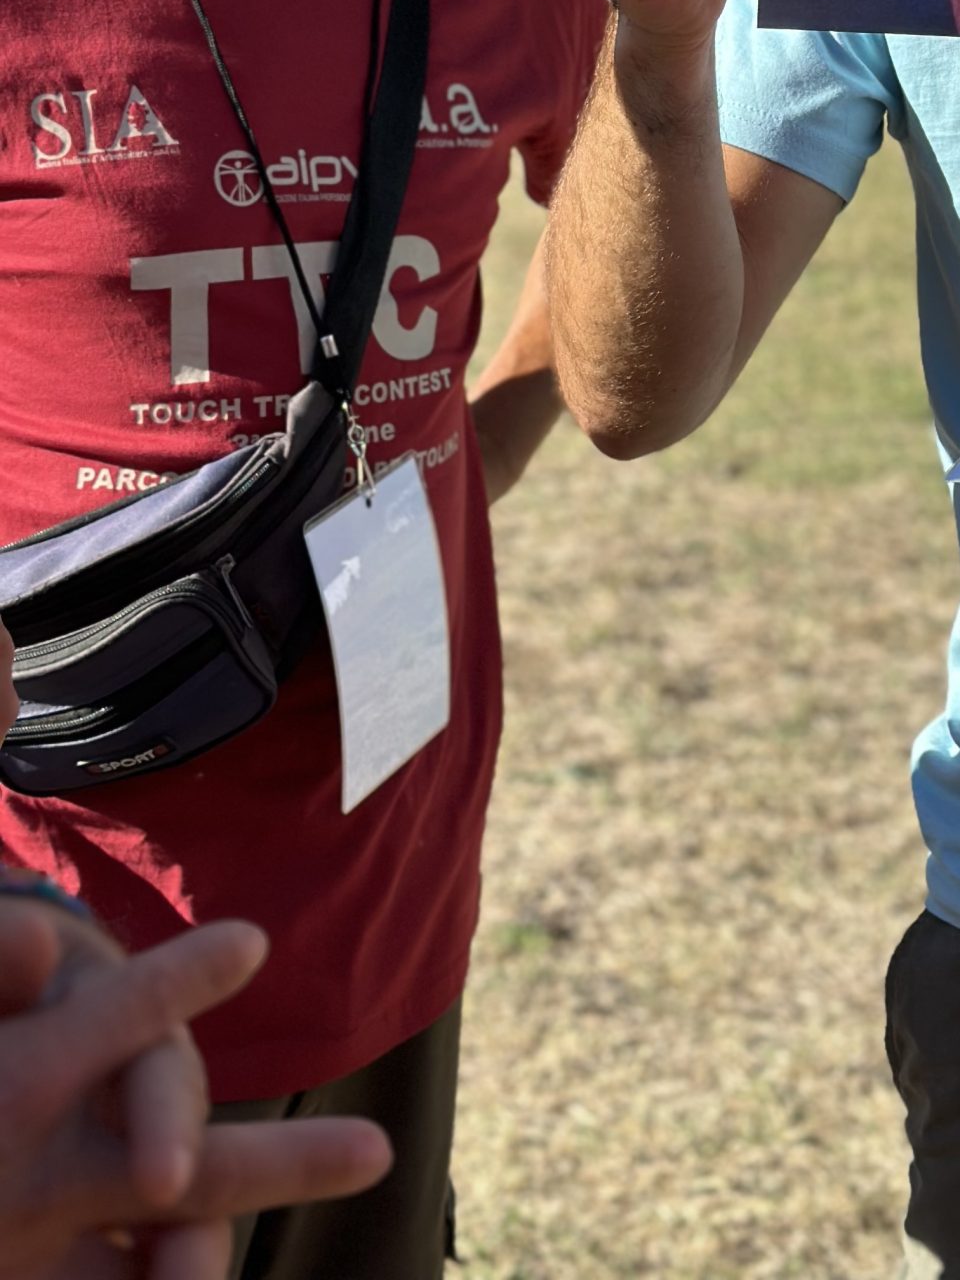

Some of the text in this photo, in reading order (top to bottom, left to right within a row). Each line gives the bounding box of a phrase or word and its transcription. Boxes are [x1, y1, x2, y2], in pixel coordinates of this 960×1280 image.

[31, 85, 179, 160] SIA
[354, 368, 452, 406] CONTEST
[129, 397, 241, 425] TOUCH
[99, 749, 156, 773] SPORT
